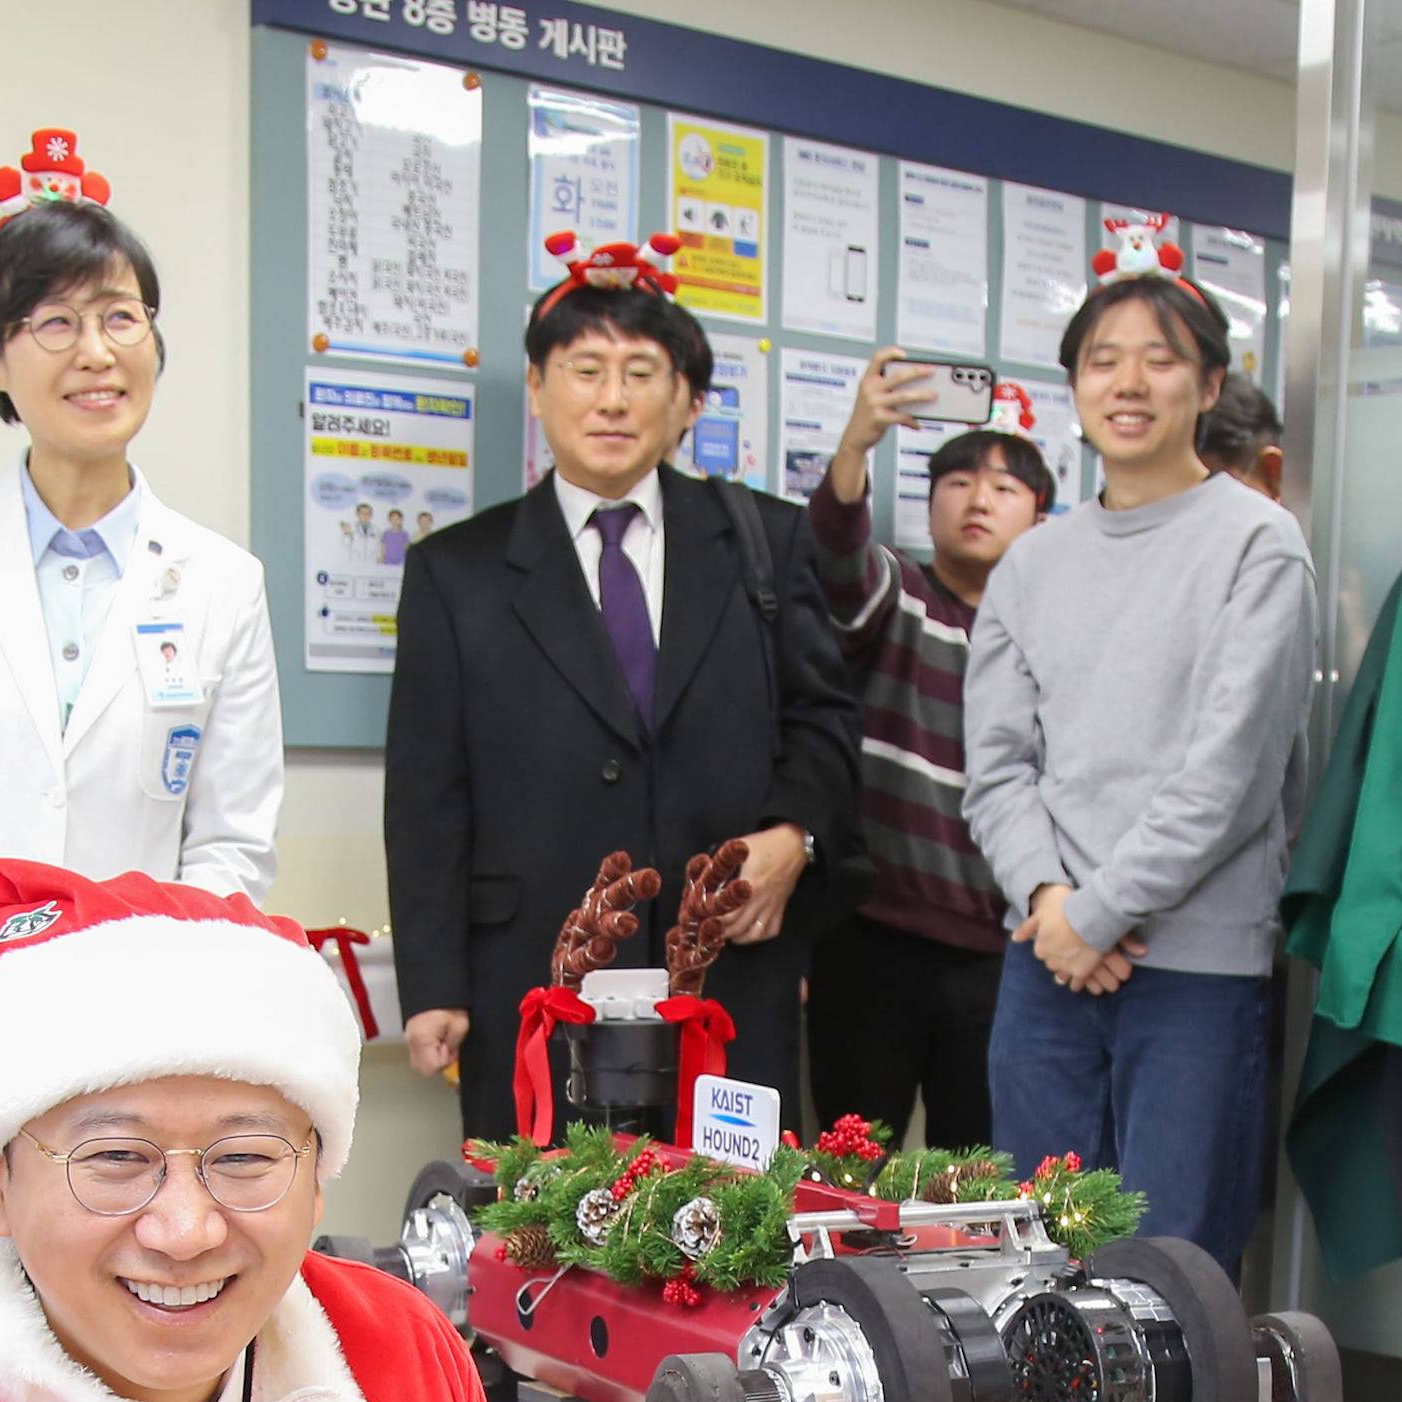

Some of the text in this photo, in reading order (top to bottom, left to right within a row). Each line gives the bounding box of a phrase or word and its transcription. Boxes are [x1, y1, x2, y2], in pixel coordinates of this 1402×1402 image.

[466, 0, 529, 50] 병동
[538, 16, 627, 70] 게시판
[552, 174, 585, 224] 화
[711, 1087, 754, 1116] KAIST
[703, 1126, 760, 1161] HOUND2
